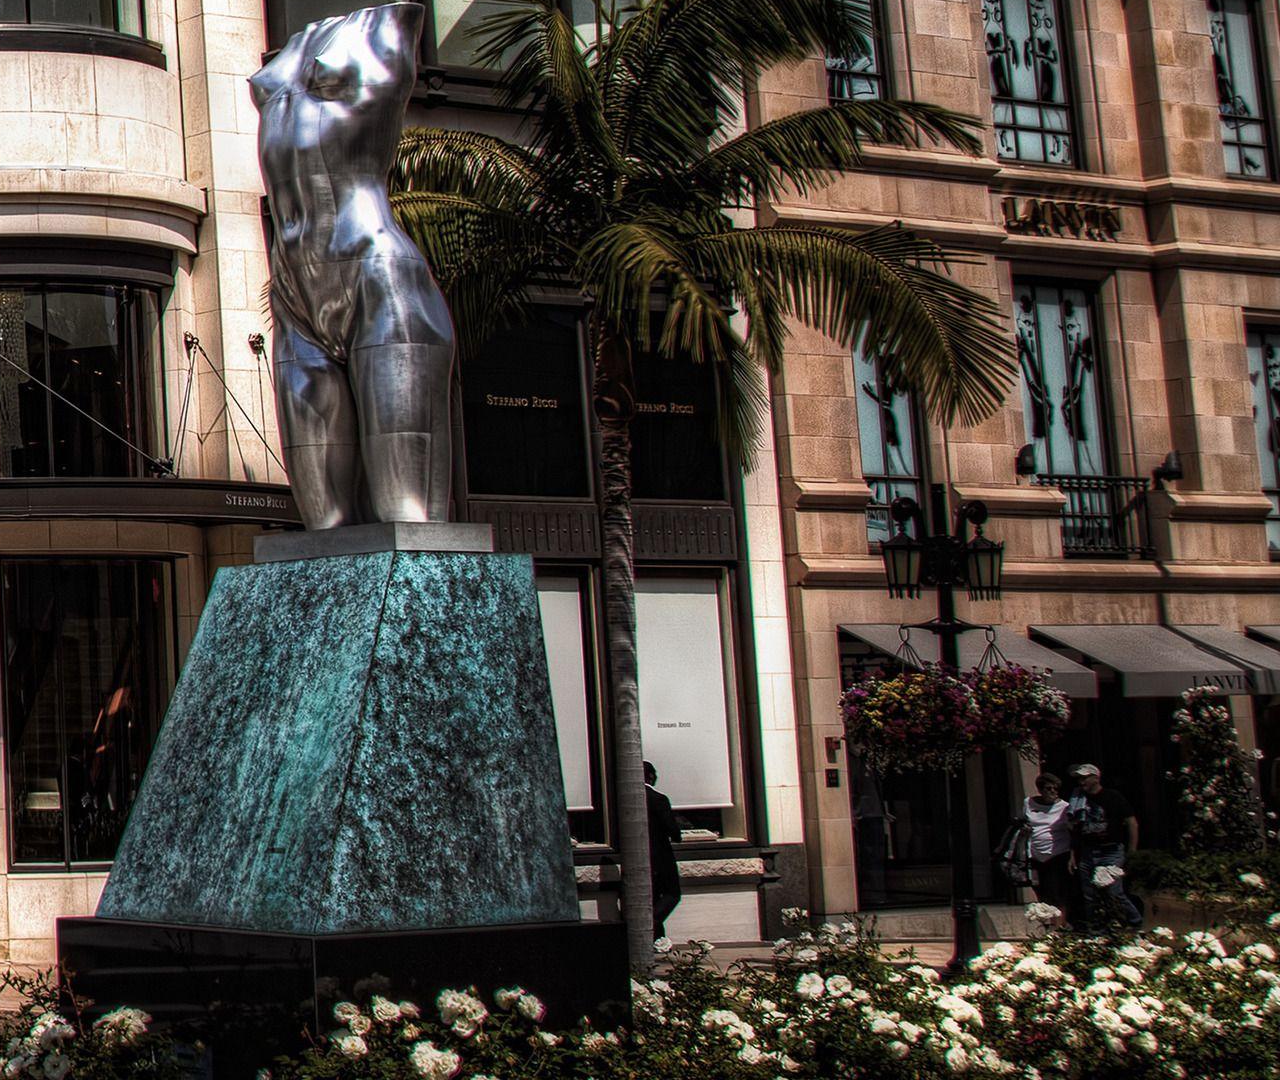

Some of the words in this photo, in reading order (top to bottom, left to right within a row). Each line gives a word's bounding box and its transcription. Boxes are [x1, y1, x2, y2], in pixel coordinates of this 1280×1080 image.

[1001, 196, 1121, 234] LANVIN
[486, 394, 529, 407] STEFANO
[532, 396, 558, 409] RICCI
[670, 403, 694, 414] RICCI
[225, 493, 265, 507] STEFANO
[266, 496, 287, 509] RICCI
[1192, 674, 1256, 690] LANVIN
